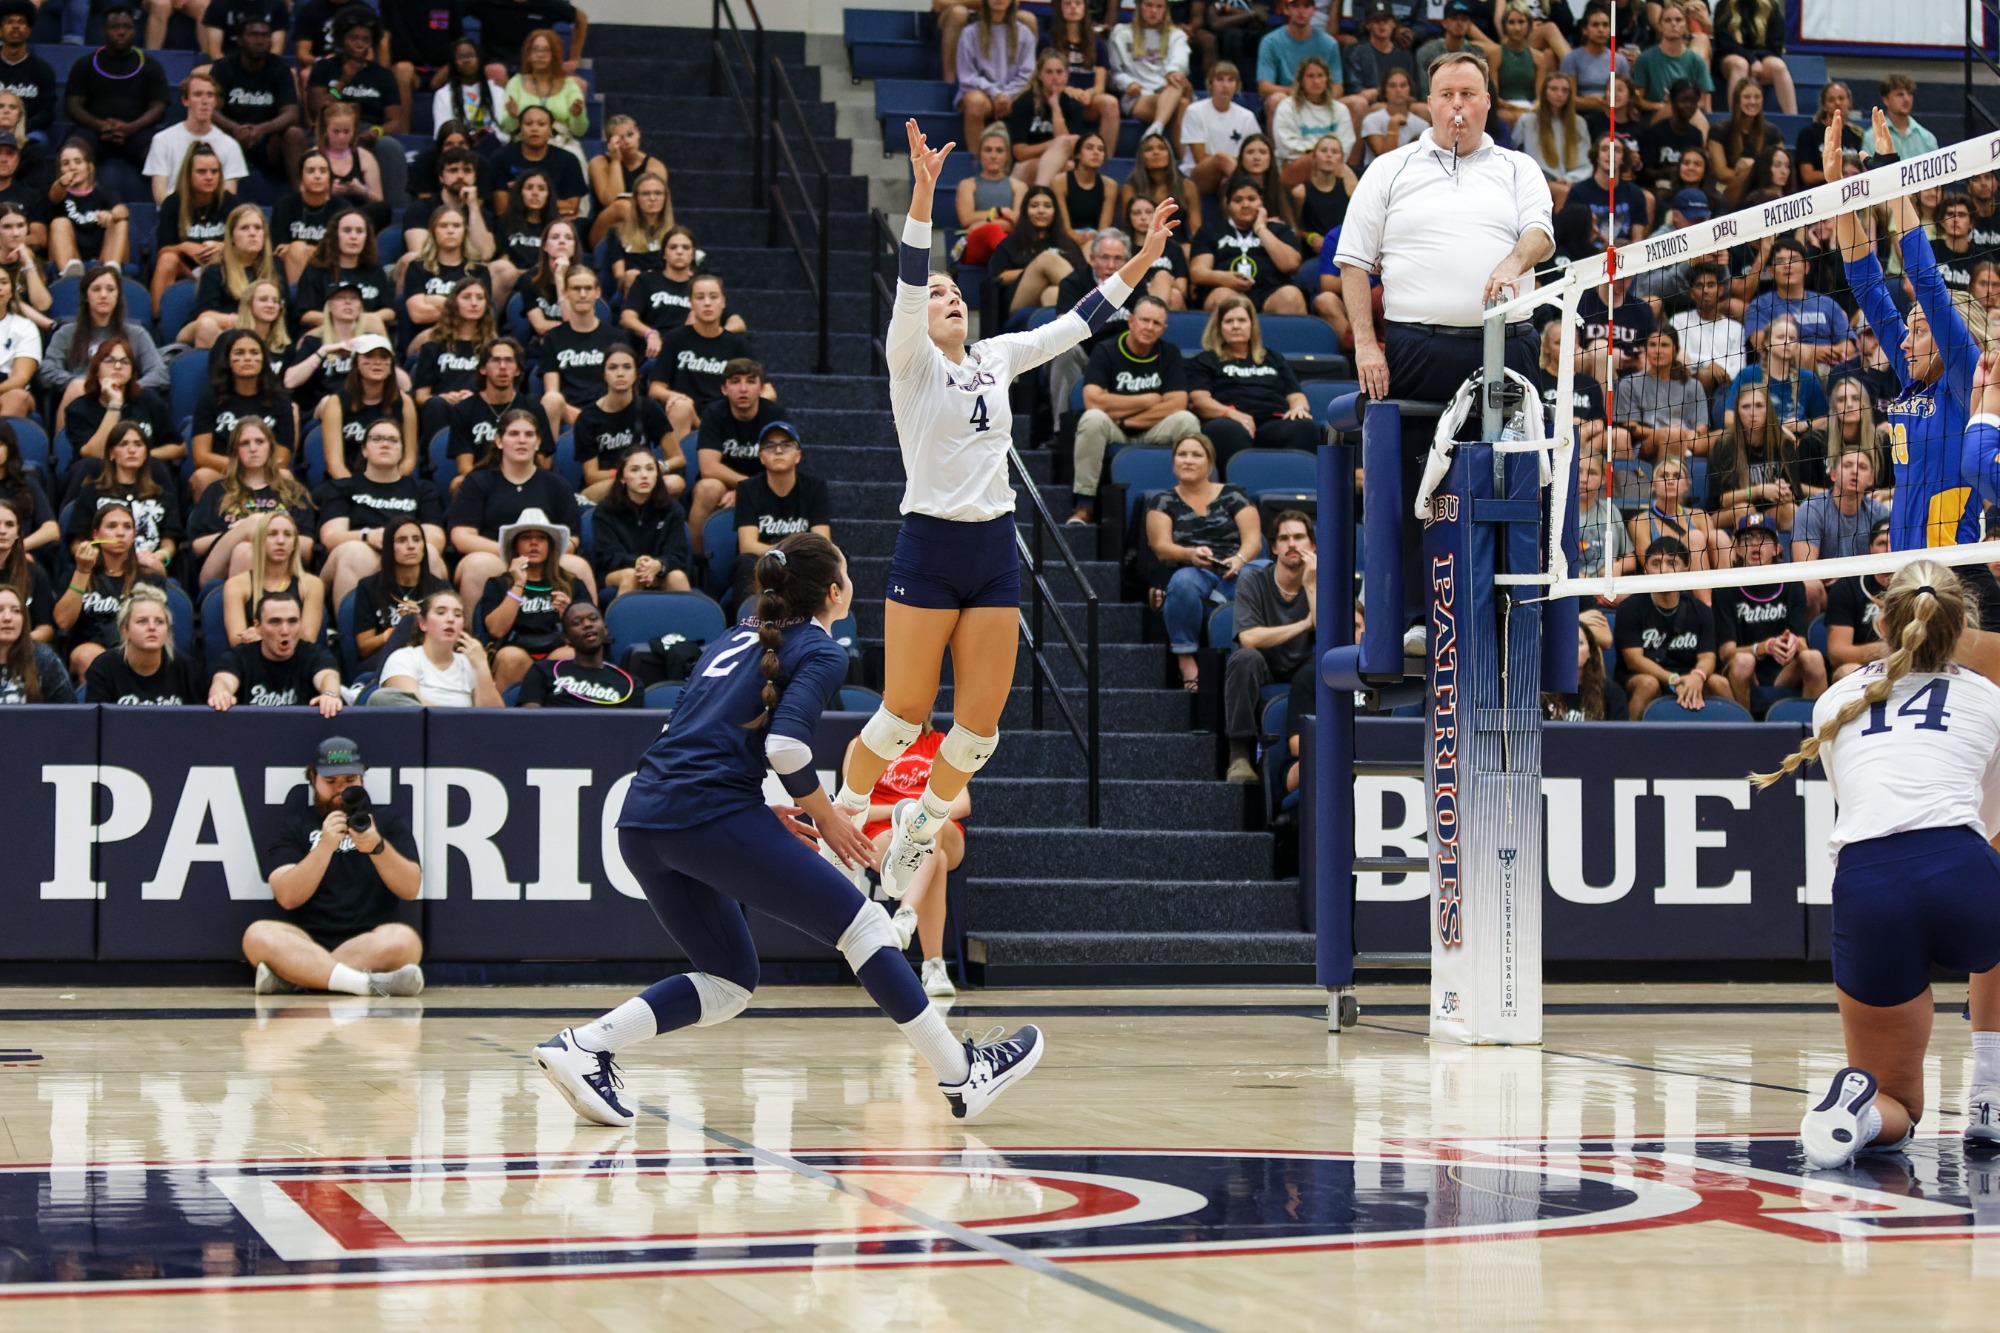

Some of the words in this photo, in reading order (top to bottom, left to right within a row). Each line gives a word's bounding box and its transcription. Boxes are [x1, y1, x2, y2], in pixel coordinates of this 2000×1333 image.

[1646, 234, 1689, 262] PATRIOTS
[1712, 220, 1738, 244] DBU
[1764, 195, 1813, 228] PATRIOTS
[1841, 179, 1870, 205] DBU
[1901, 151, 1957, 187] PATRIOTS
[1586, 324, 1634, 342] DBU
[556, 349, 604, 369] Patrio
[677, 350, 728, 374] Patriot
[970, 395, 990, 432] 4
[702, 631, 760, 678] 2
[1861, 677, 1951, 736] 14
[1433, 552, 1463, 949] PATRIOTS
